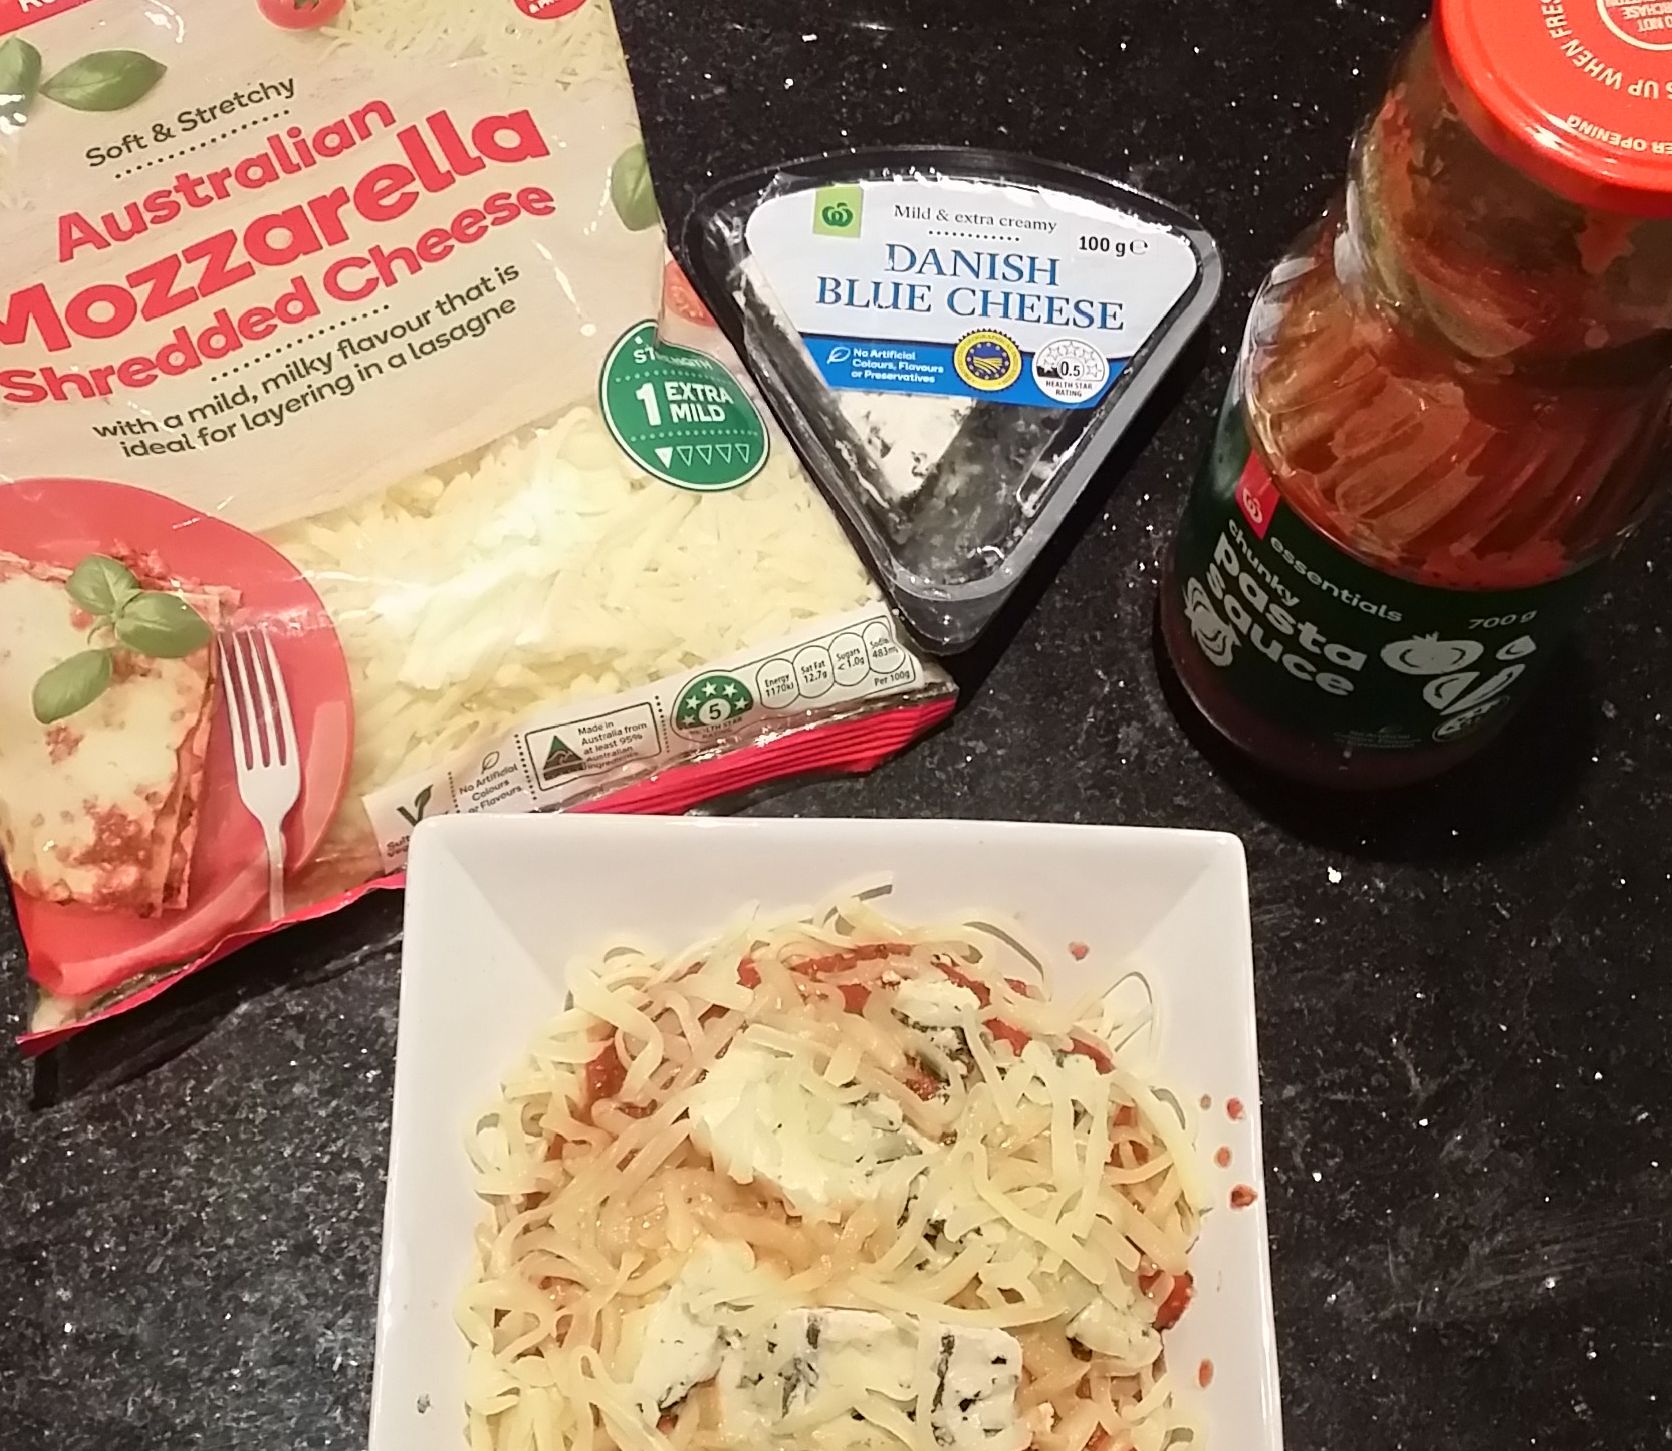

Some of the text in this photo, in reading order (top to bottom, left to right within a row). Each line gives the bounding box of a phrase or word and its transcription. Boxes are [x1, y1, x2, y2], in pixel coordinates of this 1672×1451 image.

[1560, 38, 1623, 91] WHEN
[1628, 79, 1659, 99] UP
[85, 77, 294, 167] Soft & Stretchy
[1566, 114, 1647, 152] OPENING
[58, 99, 396, 263] Australian
[0, 108, 551, 352] Mozzarella
[894, 203, 1058, 234] Mild & extra creamy
[1079, 235, 1110, 252] 100
[1115, 242, 1126, 257] g
[883, 243, 1060, 287] DANISH
[0, 186, 557, 403] Shredded Cheese
[815, 276, 1124, 331] BLUE CHEESE
[92, 264, 520, 437] with a mild, milky flavour that is
[853, 348, 916, 361] No Artificial
[119, 298, 517, 458] ideal for layering in a lasagne
[851, 370, 936, 384] or Preservatives
[852, 359, 944, 374] Colours, Flavours
[1061, 361, 1081, 377] 0.5
[1045, 380, 1093, 390] HEALTH STAR
[1055, 389, 1082, 398] RATING
[635, 381, 734, 427] 1 EXTRA
[669, 403, 726, 424] MILD
[1229, 519, 1300, 607] chunky
[1270, 536, 1403, 623] essentials
[1213, 531, 1368, 672] pasta
[1206, 562, 1355, 696] sauce
[1468, 609, 1538, 630] 700 g
[836, 648, 861, 662] Sugars
[800, 660, 826, 675] Sat Fat
[804, 672, 828, 684] 12.7g
[874, 670, 910, 687] Per 100g
[764, 674, 790, 688] Energy
[709, 703, 721, 720] 5
[577, 721, 614, 736] Made in
[581, 722, 648, 746] Australia from
[584, 734, 643, 756] at least 95%
[586, 746, 634, 763] Australian
[459, 763, 518, 796] No Artificial
[472, 779, 510, 802] Colours
[480, 785, 523, 811] Flavours
